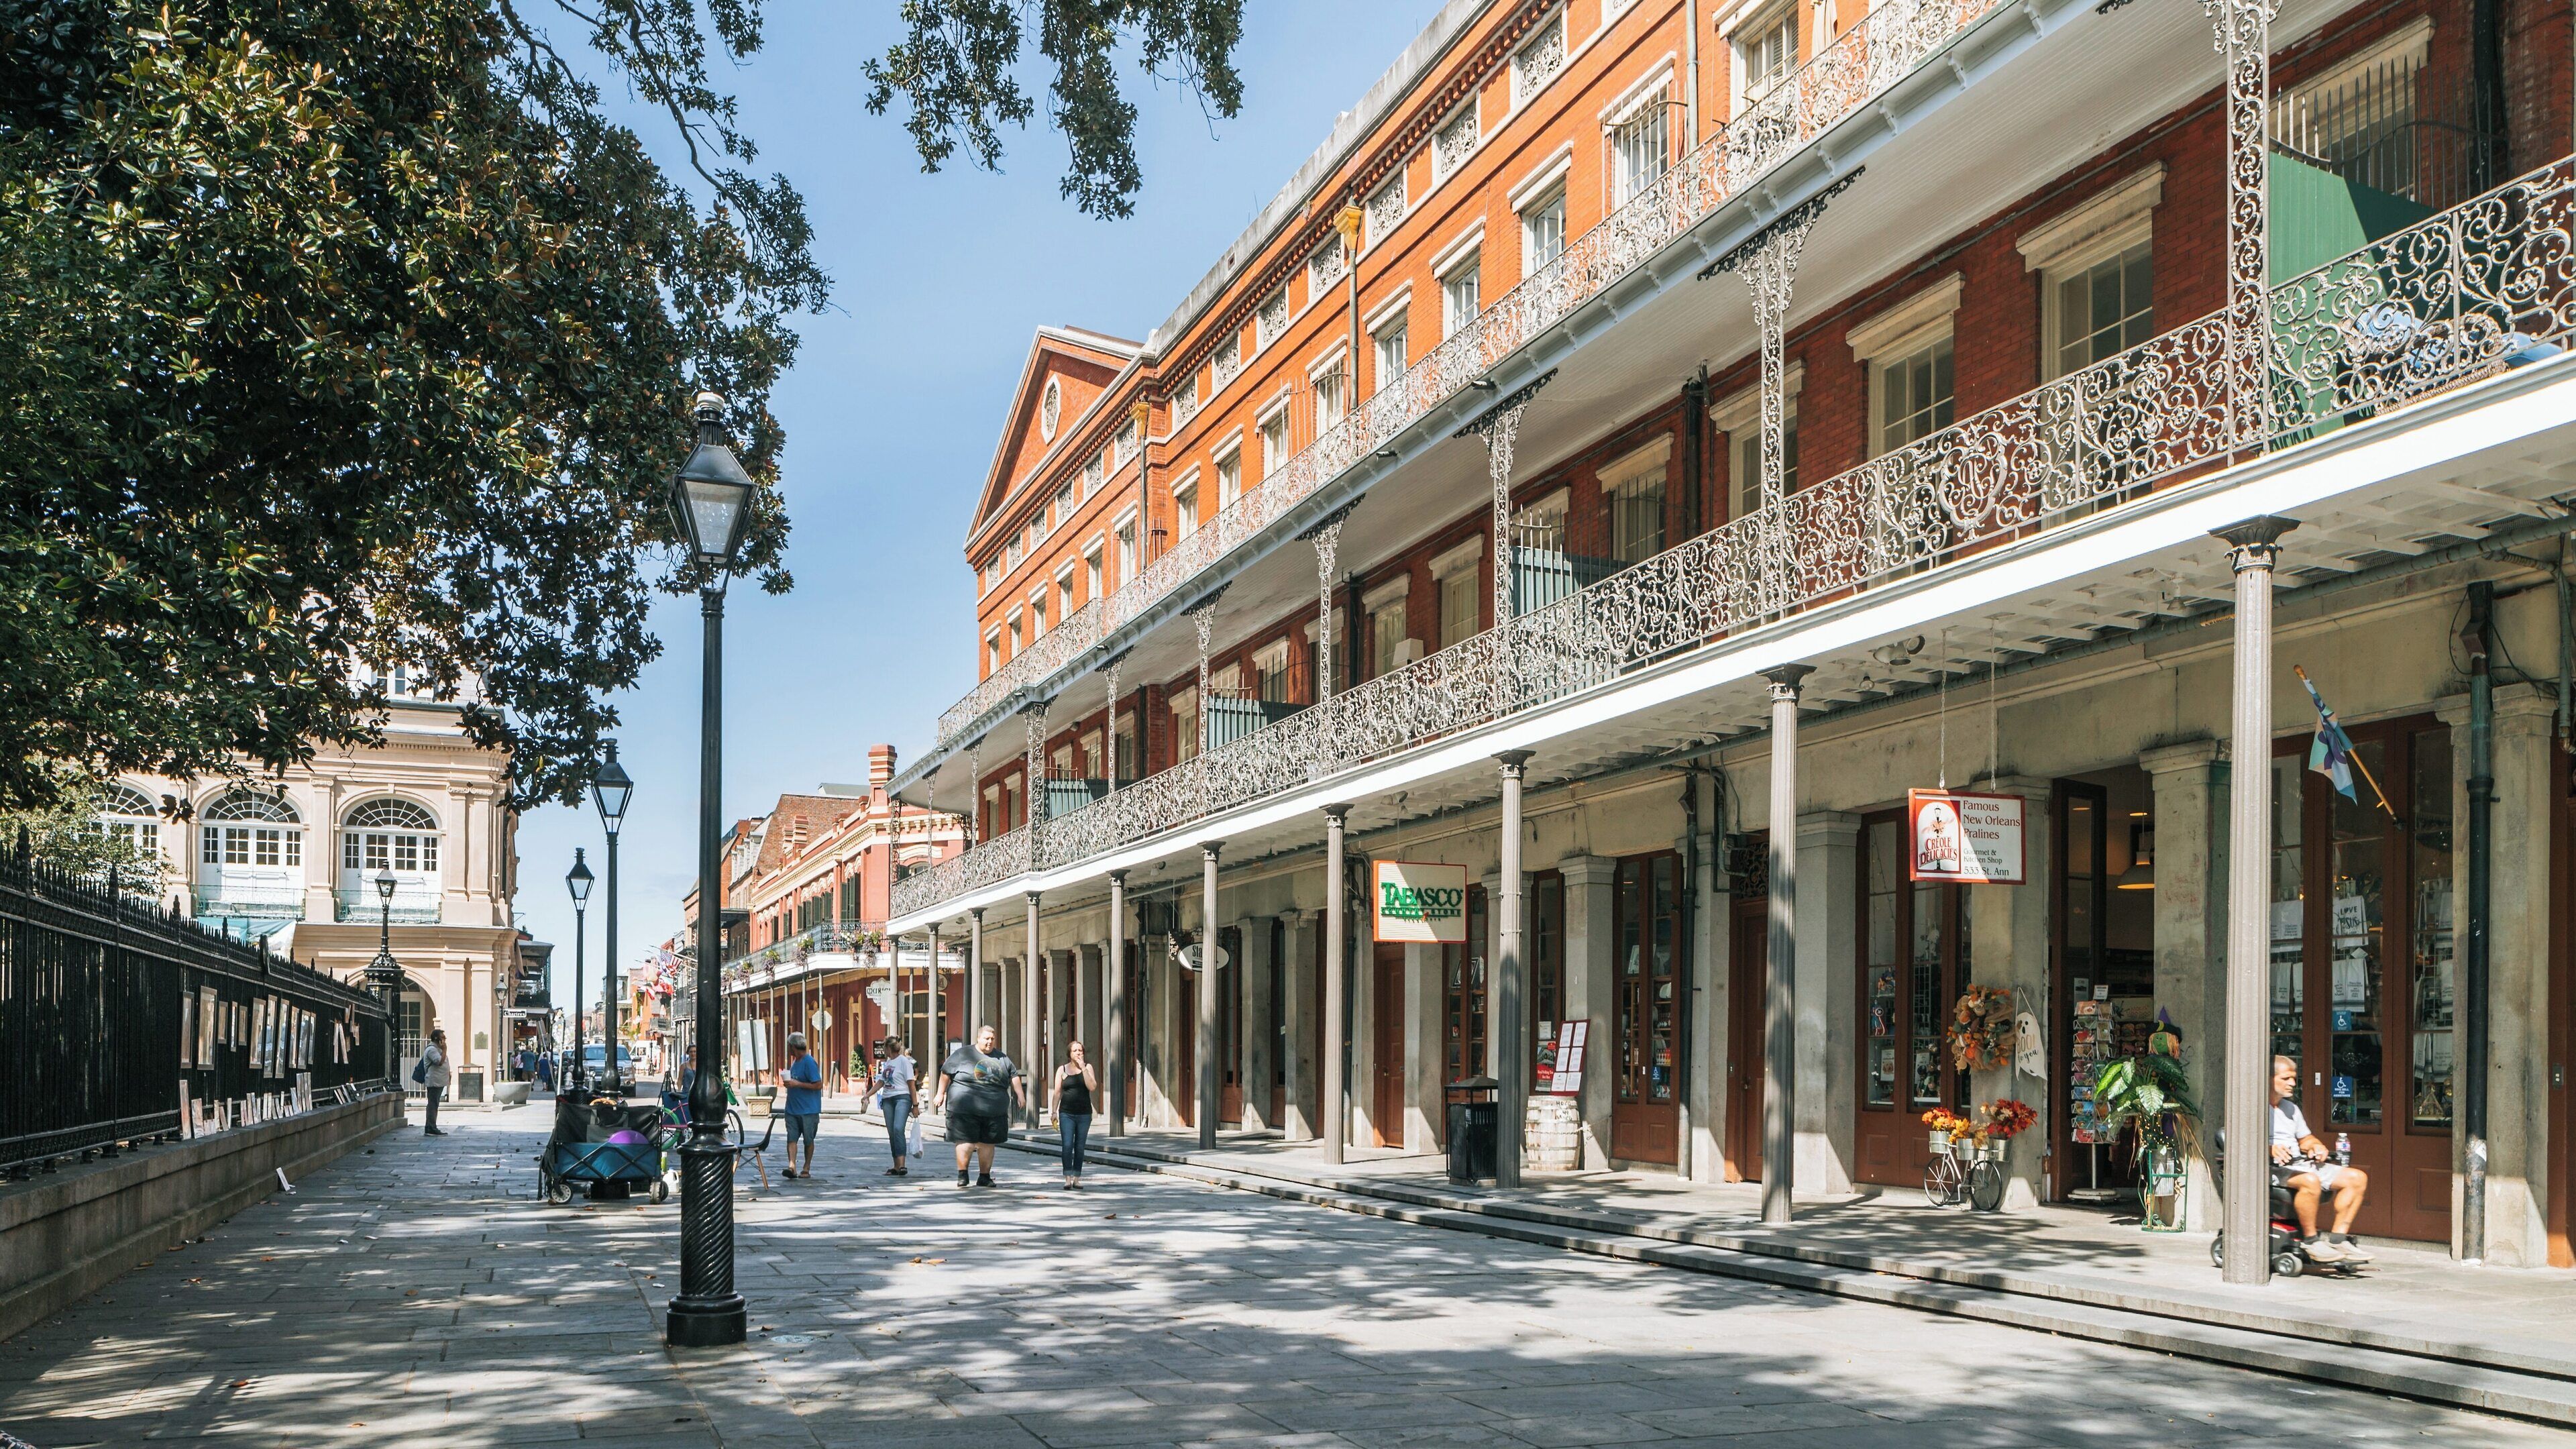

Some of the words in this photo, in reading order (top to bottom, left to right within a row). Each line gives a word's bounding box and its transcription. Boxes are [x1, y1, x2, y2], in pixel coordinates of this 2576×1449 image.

[1963, 800, 2000, 812] Famous
[1963, 814, 1983, 824] New
[1985, 815, 2021, 827] Orleans
[1964, 828, 2000, 839] Pralines
[1925, 837, 1952, 852] CREOLE
[1919, 849, 1957, 865] DELICACIES
[1964, 848, 1990, 856] Gourmet
[1964, 867, 1980, 875] 533
[1982, 867, 1992, 875] St.
[1994, 867, 2010, 876] Ann
[1381, 881, 1463, 907] TABASCO
[2024, 1049, 2039, 1064] you
